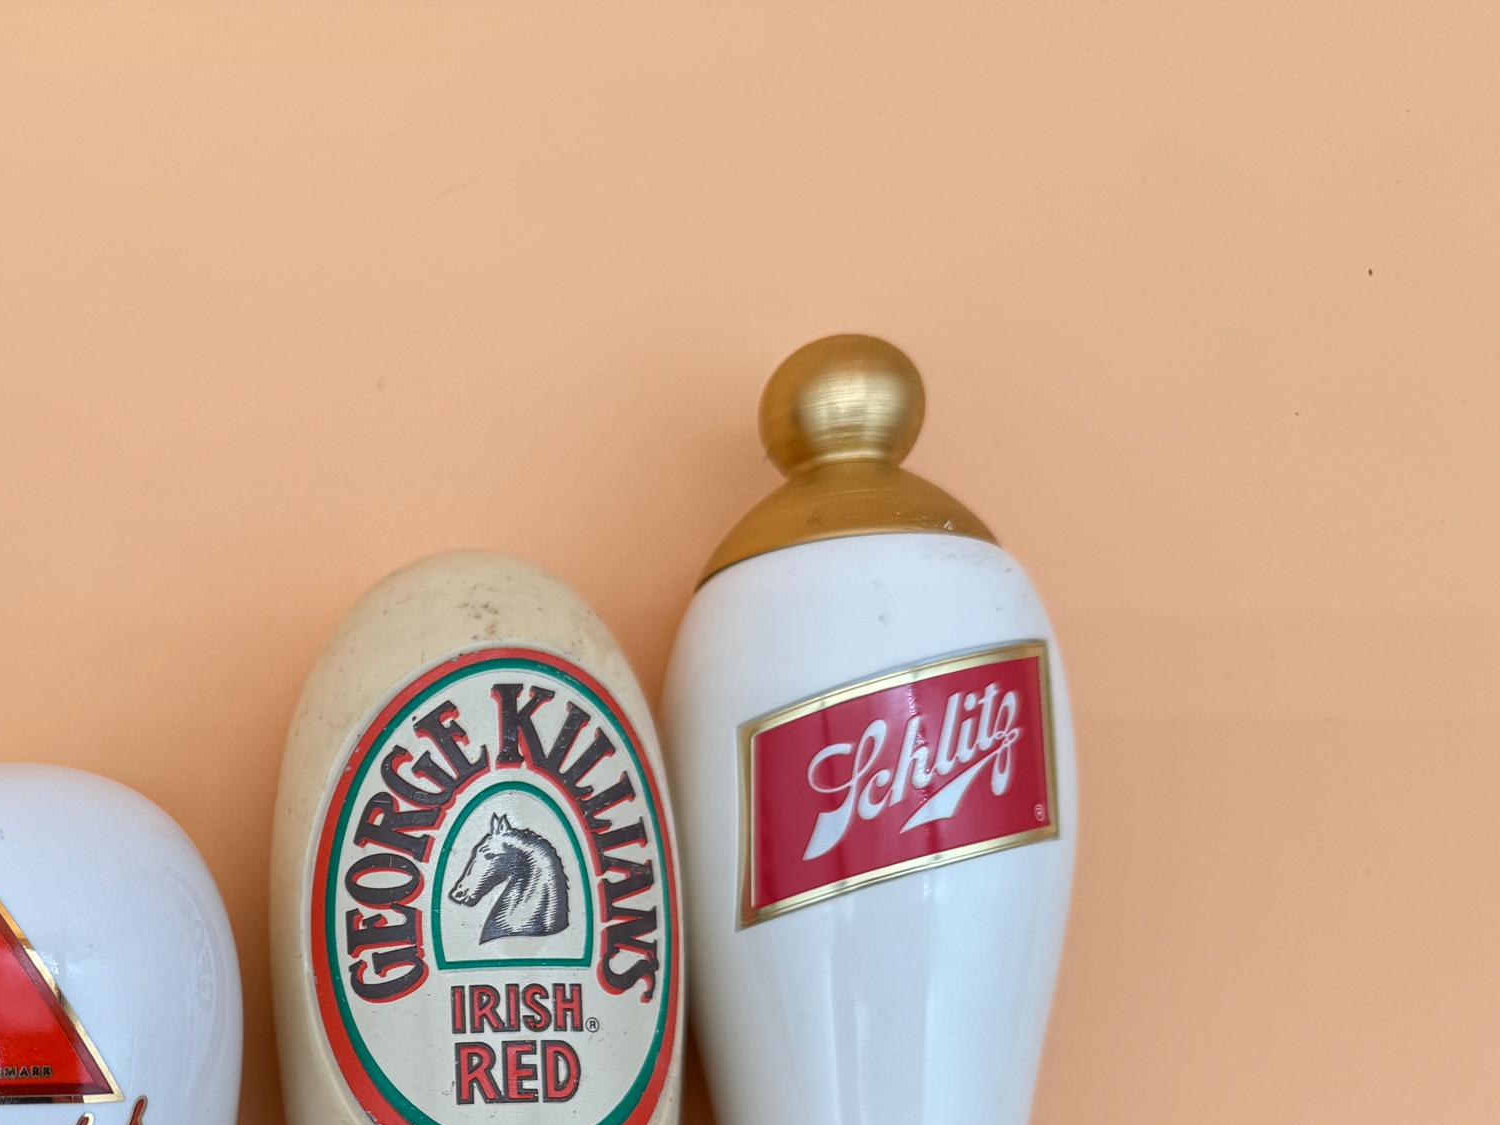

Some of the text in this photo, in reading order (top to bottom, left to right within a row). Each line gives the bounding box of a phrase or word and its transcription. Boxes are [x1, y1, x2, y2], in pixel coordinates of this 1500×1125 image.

[802, 682, 1021, 861] Schlitz
[344, 699, 490, 1004] GEORGE
[450, 983, 584, 1034] IRISH
[454, 1040, 582, 1105] RED
